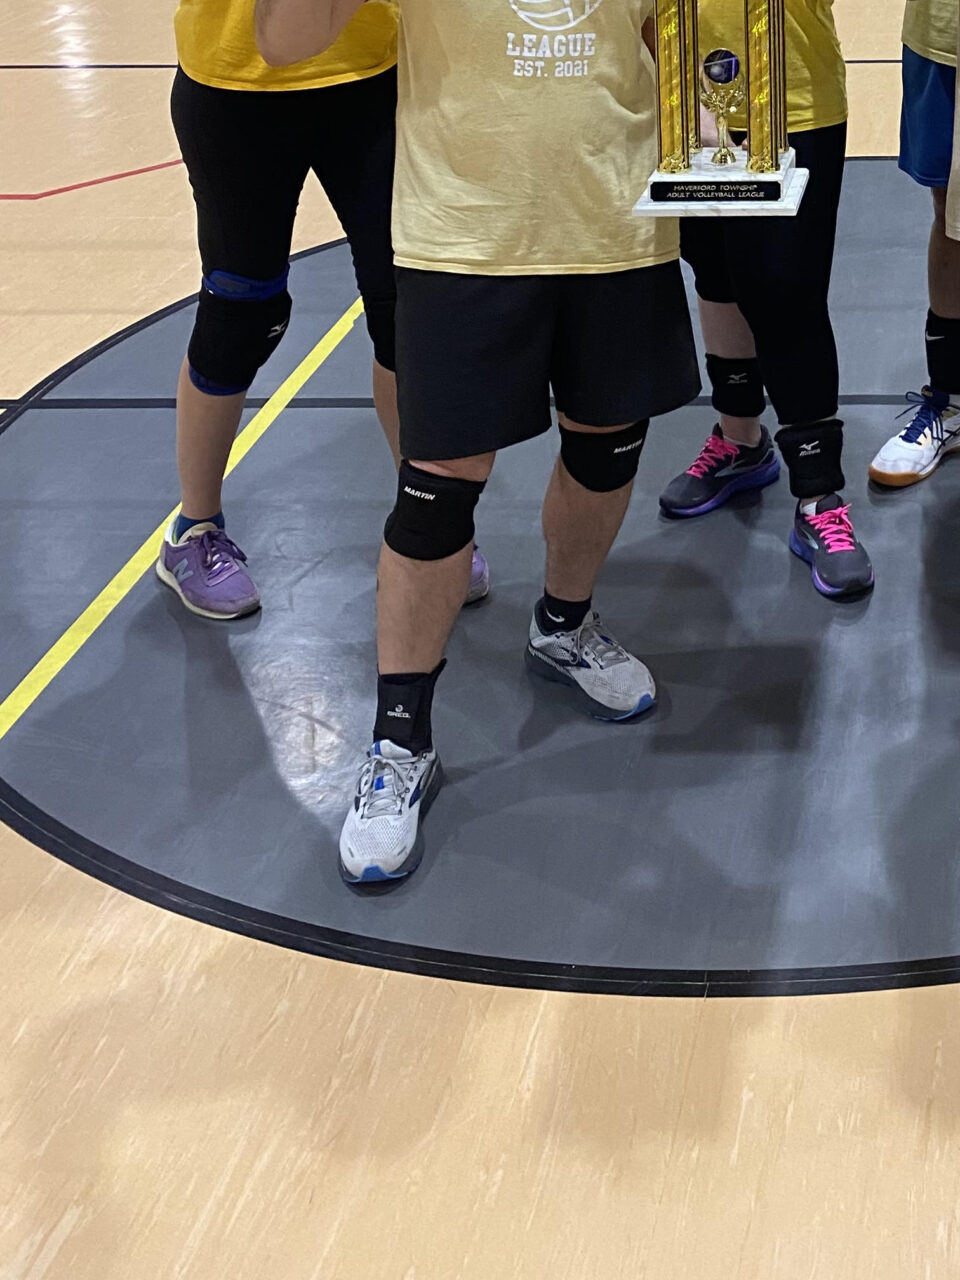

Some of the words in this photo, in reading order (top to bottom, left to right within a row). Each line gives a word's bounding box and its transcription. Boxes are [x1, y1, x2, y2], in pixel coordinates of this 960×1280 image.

[506, 32, 597, 58] LEAGUE
[513, 59, 549, 78] EST.
[554, 59, 589, 78] 2021
[403, 485, 436, 501] MARTIN
